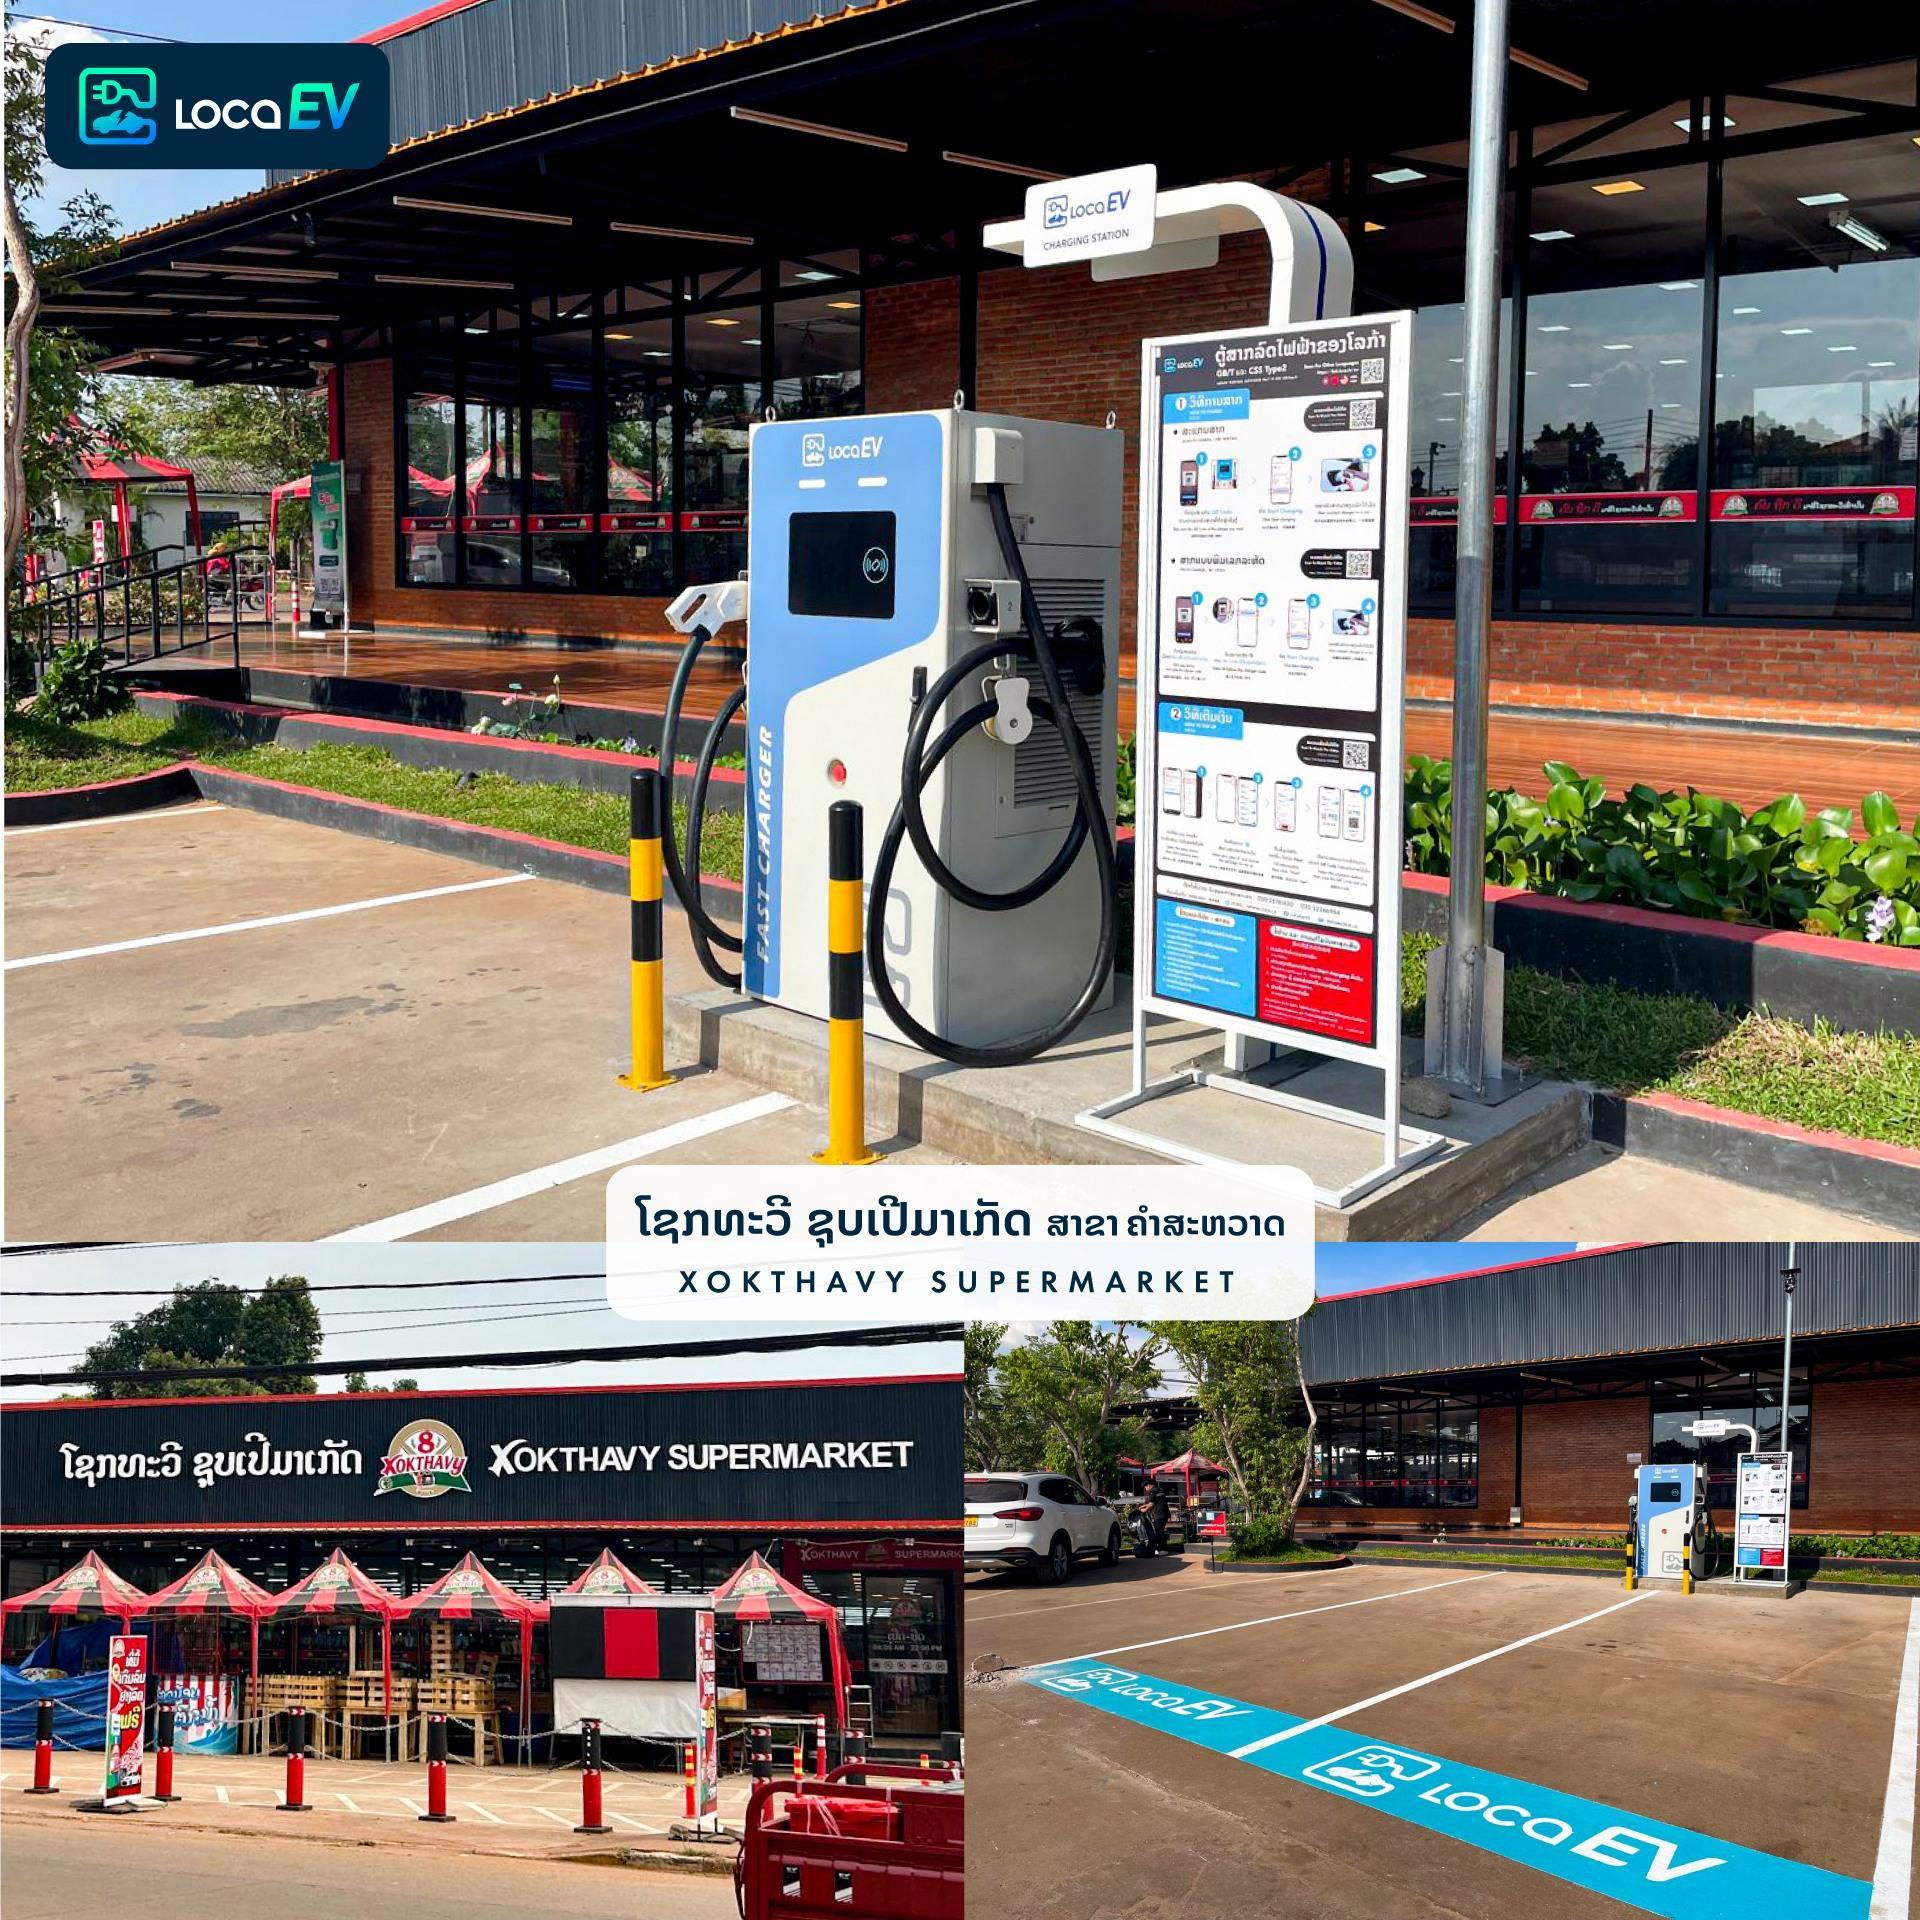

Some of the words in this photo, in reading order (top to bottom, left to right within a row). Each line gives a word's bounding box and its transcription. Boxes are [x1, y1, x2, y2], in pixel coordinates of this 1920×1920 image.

[1106, 189, 1132, 213] EV
[1043, 234, 1090, 252] CHARGING
[1091, 229, 1130, 243] STATION
[860, 436, 884, 459] EV
[1007, 601, 1014, 612] 2
[757, 725, 773, 877] CHARGER
[756, 883, 770, 964] FAST
[417, 1430, 435, 1454] 8
[59, 1441, 184, 1489] ໂຊກທະວີ
[192, 1432, 364, 1489] ຊຸບເປີມາເກັດ
[488, 1439, 661, 1478] XOKTHAVY
[667, 1441, 914, 1471] SUPERMARKET
[800, 1547, 860, 1561] XOKTHAVY
[1170, 1698, 1254, 1722] EV
[1570, 1825, 1728, 1882] EV
